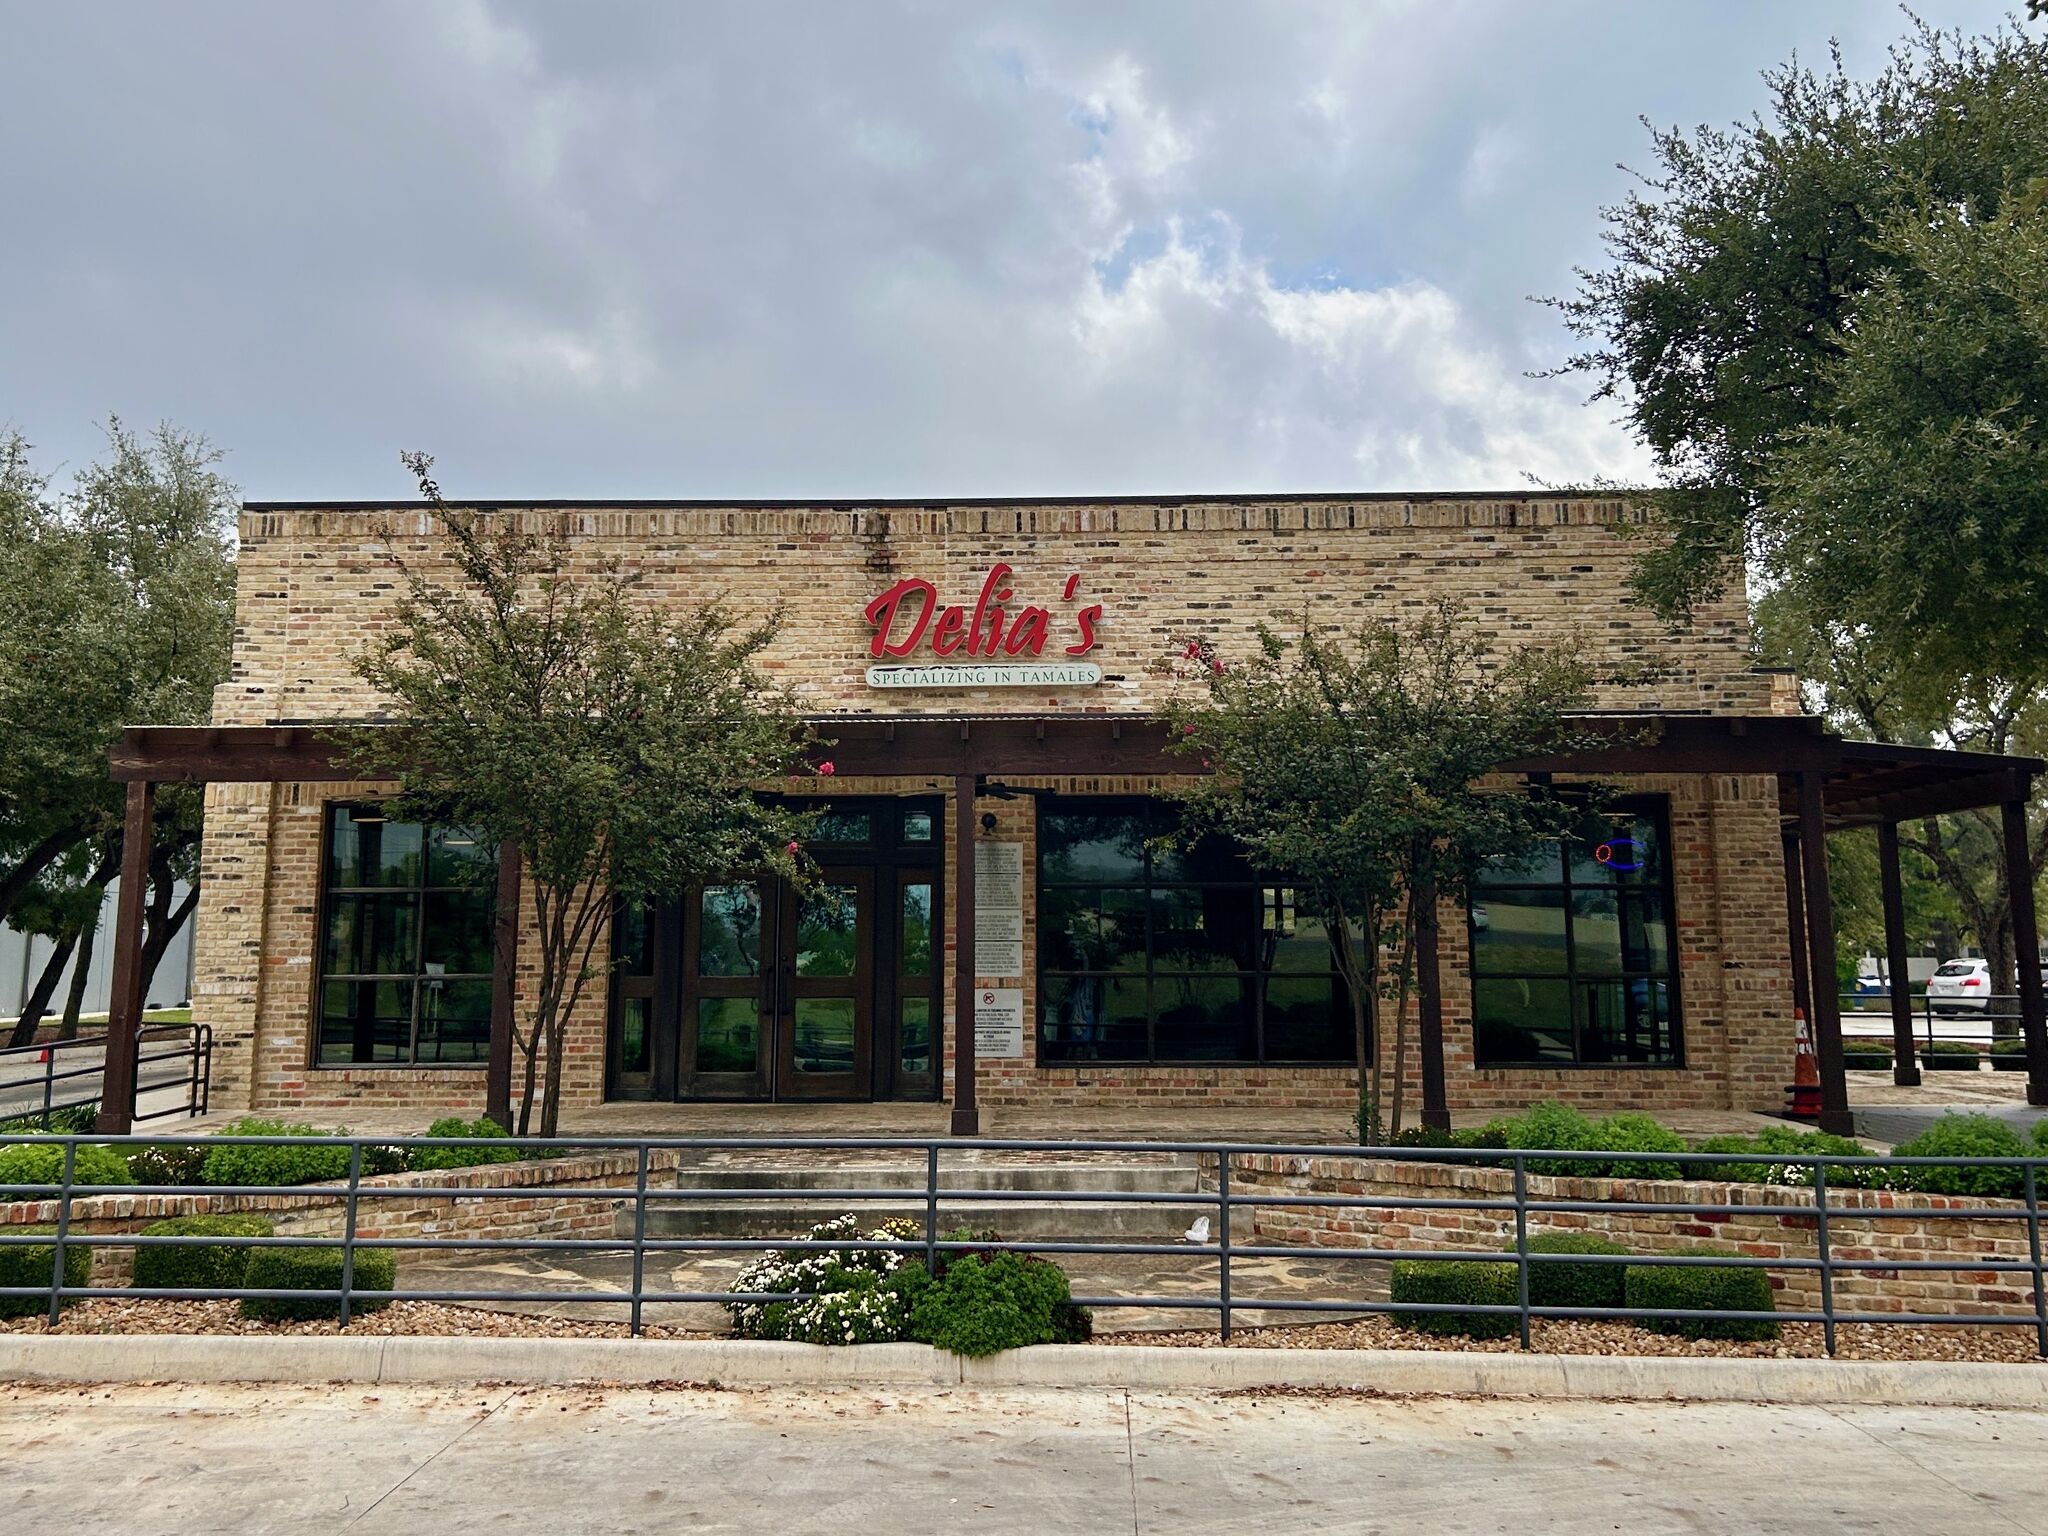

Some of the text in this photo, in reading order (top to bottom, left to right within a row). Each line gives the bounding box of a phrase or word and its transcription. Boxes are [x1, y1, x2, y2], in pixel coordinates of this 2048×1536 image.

[864, 562, 1102, 658] Delia's
[872, 670, 1096, 685] SPECIALIZING IN TAMALES
